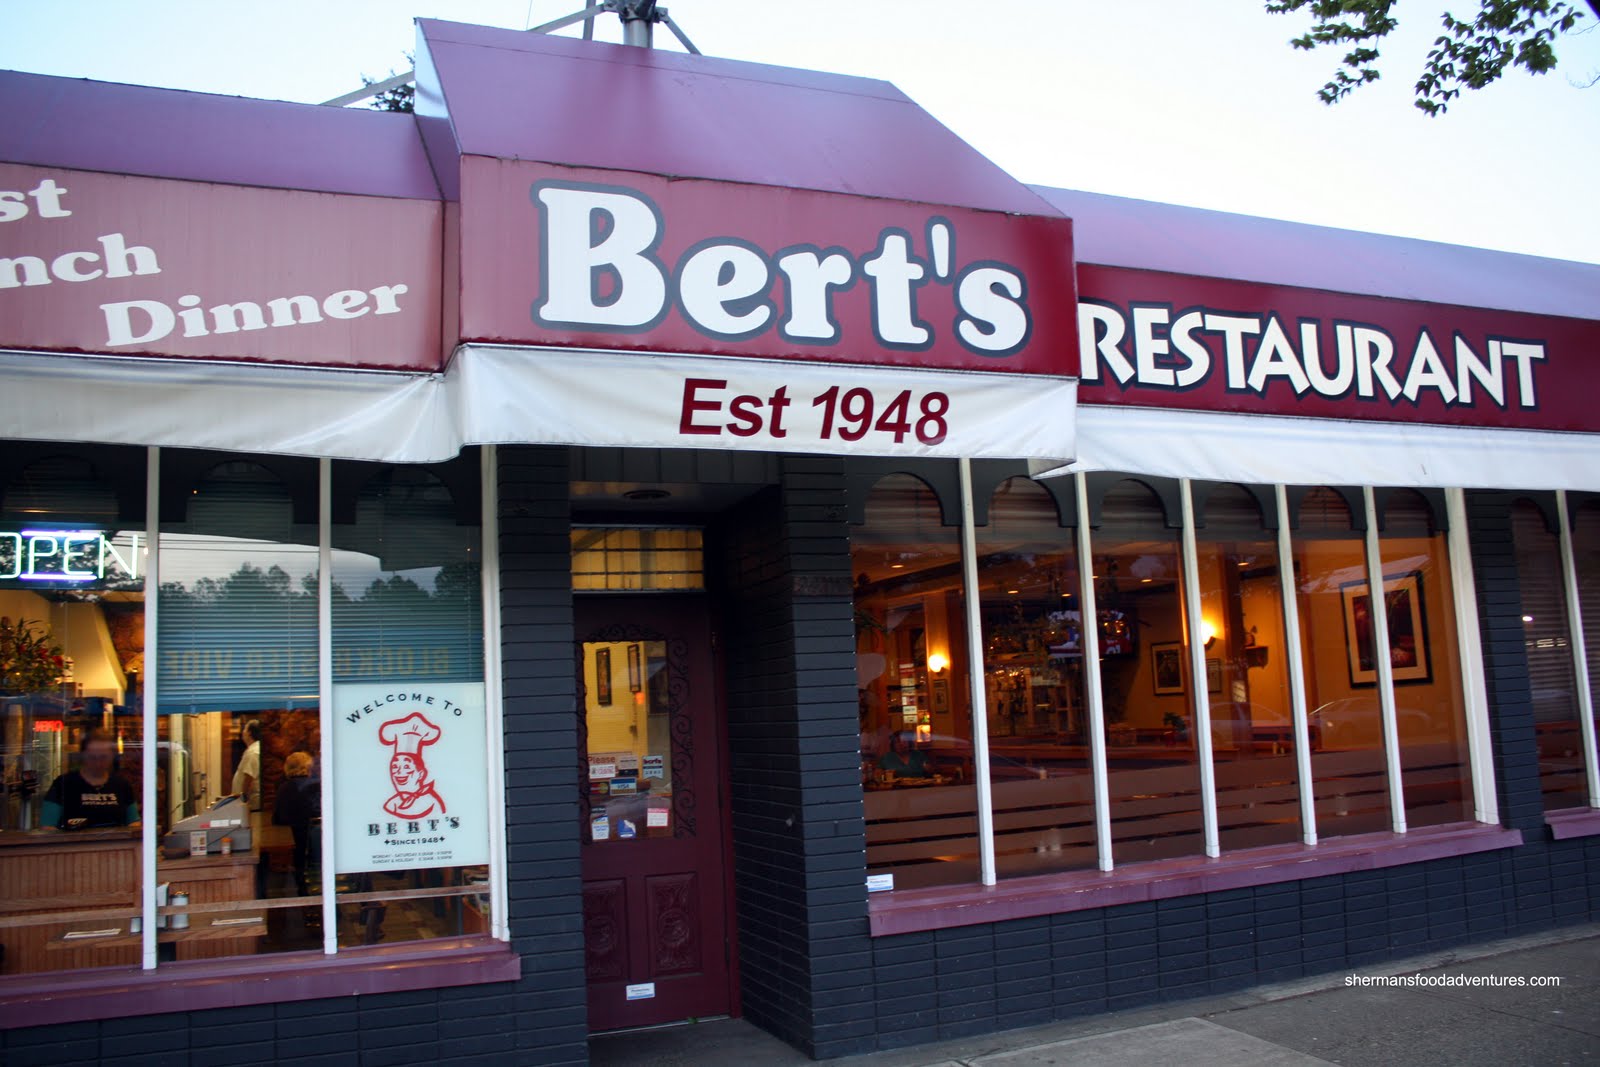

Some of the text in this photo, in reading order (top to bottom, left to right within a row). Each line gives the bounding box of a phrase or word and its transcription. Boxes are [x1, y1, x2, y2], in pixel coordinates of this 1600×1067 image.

[532, 181, 1032, 356] Bert's
[100, 284, 408, 347] Dinner
[1077, 302, 1545, 407] RESTAURANT
[679, 378, 949, 446] Est 1948
[0, 532, 138, 580] OPEN
[346, 693, 462, 724] WELCOME TO
[368, 816, 460, 836] BERT'S
